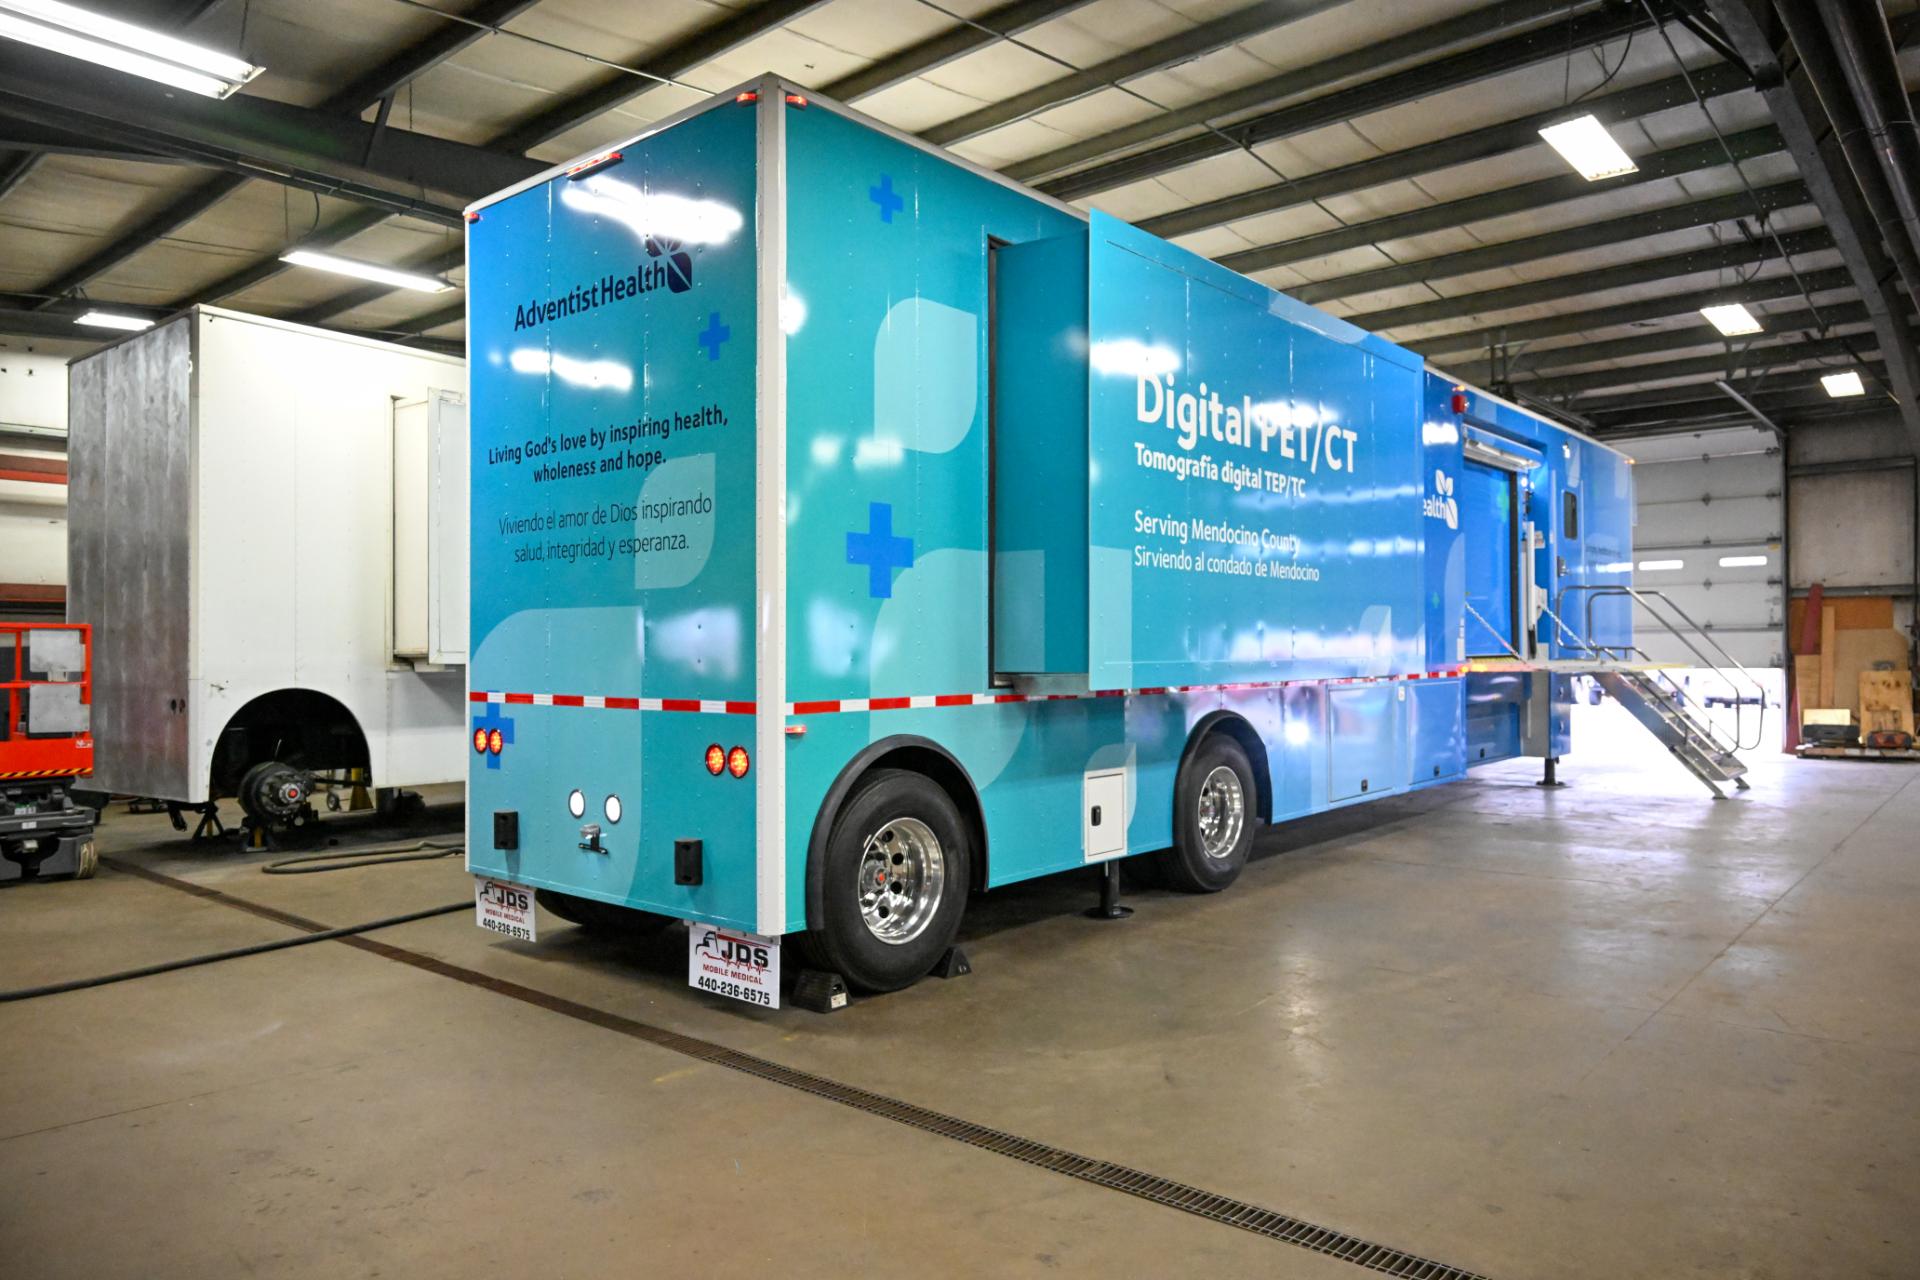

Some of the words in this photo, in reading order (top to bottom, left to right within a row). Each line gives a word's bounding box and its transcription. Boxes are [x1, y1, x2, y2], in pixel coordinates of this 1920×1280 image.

[489, 444, 522, 465] Living
[525, 436, 557, 458] God's
[560, 433, 587, 452] love
[590, 427, 606, 451] by
[610, 418, 670, 445] inspiring
[674, 404, 728, 431] health,
[1136, 370, 1251, 451] Digital
[1260, 402, 1358, 475] PET/CT
[533, 461, 596, 483] wholeness
[600, 450, 623, 473] and
[627, 448, 667, 472] hope.
[1134, 442, 1219, 482] Tomografía
[1221, 460, 1262, 492] digital
[1264, 470, 1306, 499] TEP/TC
[499, 512, 544, 536] Viviendo
[546, 510, 556, 530] el
[558, 512, 589, 529] amor
[592, 504, 607, 525] de
[610, 502, 638, 523] Dios
[642, 492, 712, 524] inspirando
[515, 542, 545, 563] salud,
[547, 535, 605, 564] integridad
[608, 540, 616, 561] y
[619, 534, 690, 558] esperanza.
[1134, 509, 1188, 545] Serving
[1191, 518, 1259, 546] Mendocino
[1261, 528, 1300, 559] County
[1134, 545, 1192, 571] Sirviendo
[1194, 551, 1205, 571] al
[1207, 555, 1252, 577] condado
[1254, 558, 1268, 577] de
[1270, 561, 1320, 582] Mendocino
[496, 889, 529, 911] JDS
[482, 917, 531, 940] 440-236-6575
[721, 941, 769, 969] JDS
[697, 975, 771, 1006] 440-236-6575
[703, 963, 729, 977] MOBILE
[730, 970, 763, 985] MEDICAL
